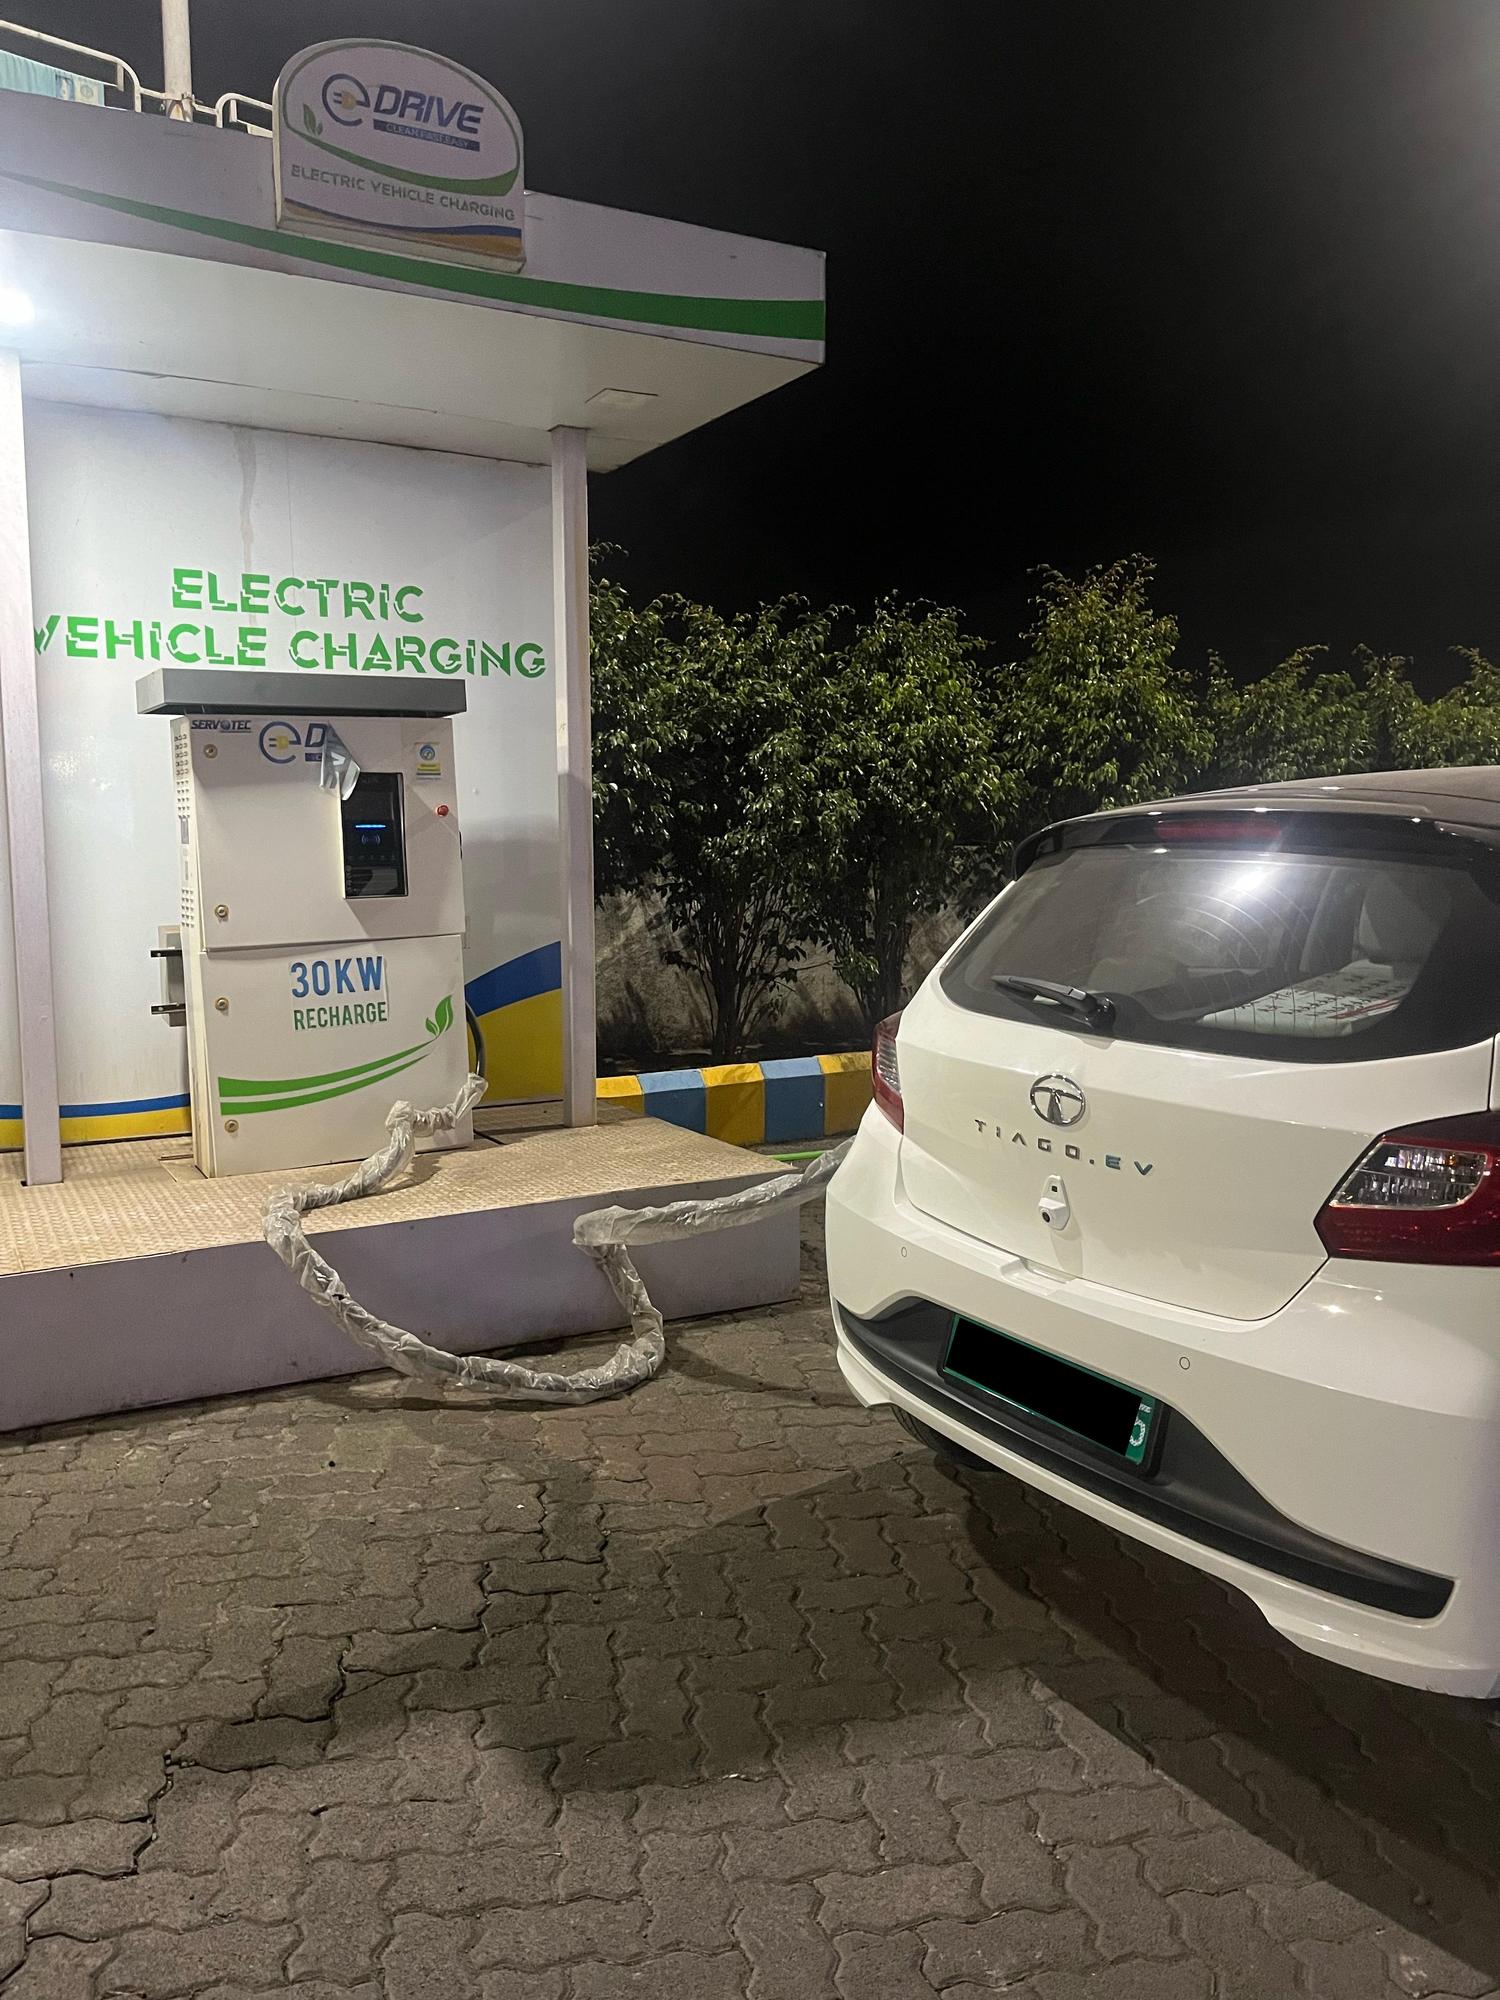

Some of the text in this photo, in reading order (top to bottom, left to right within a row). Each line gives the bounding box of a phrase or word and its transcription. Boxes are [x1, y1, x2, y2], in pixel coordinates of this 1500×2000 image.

[373, 84, 484, 134] DRIVE
[291, 164, 515, 221] ELECTRIC VEHICLE CHARGING
[172, 567, 425, 623] ELECTRIC
[289, 629, 547, 679] CHARGING
[290, 956, 383, 998] 30KW
[293, 1001, 388, 1031] RECHARGE
